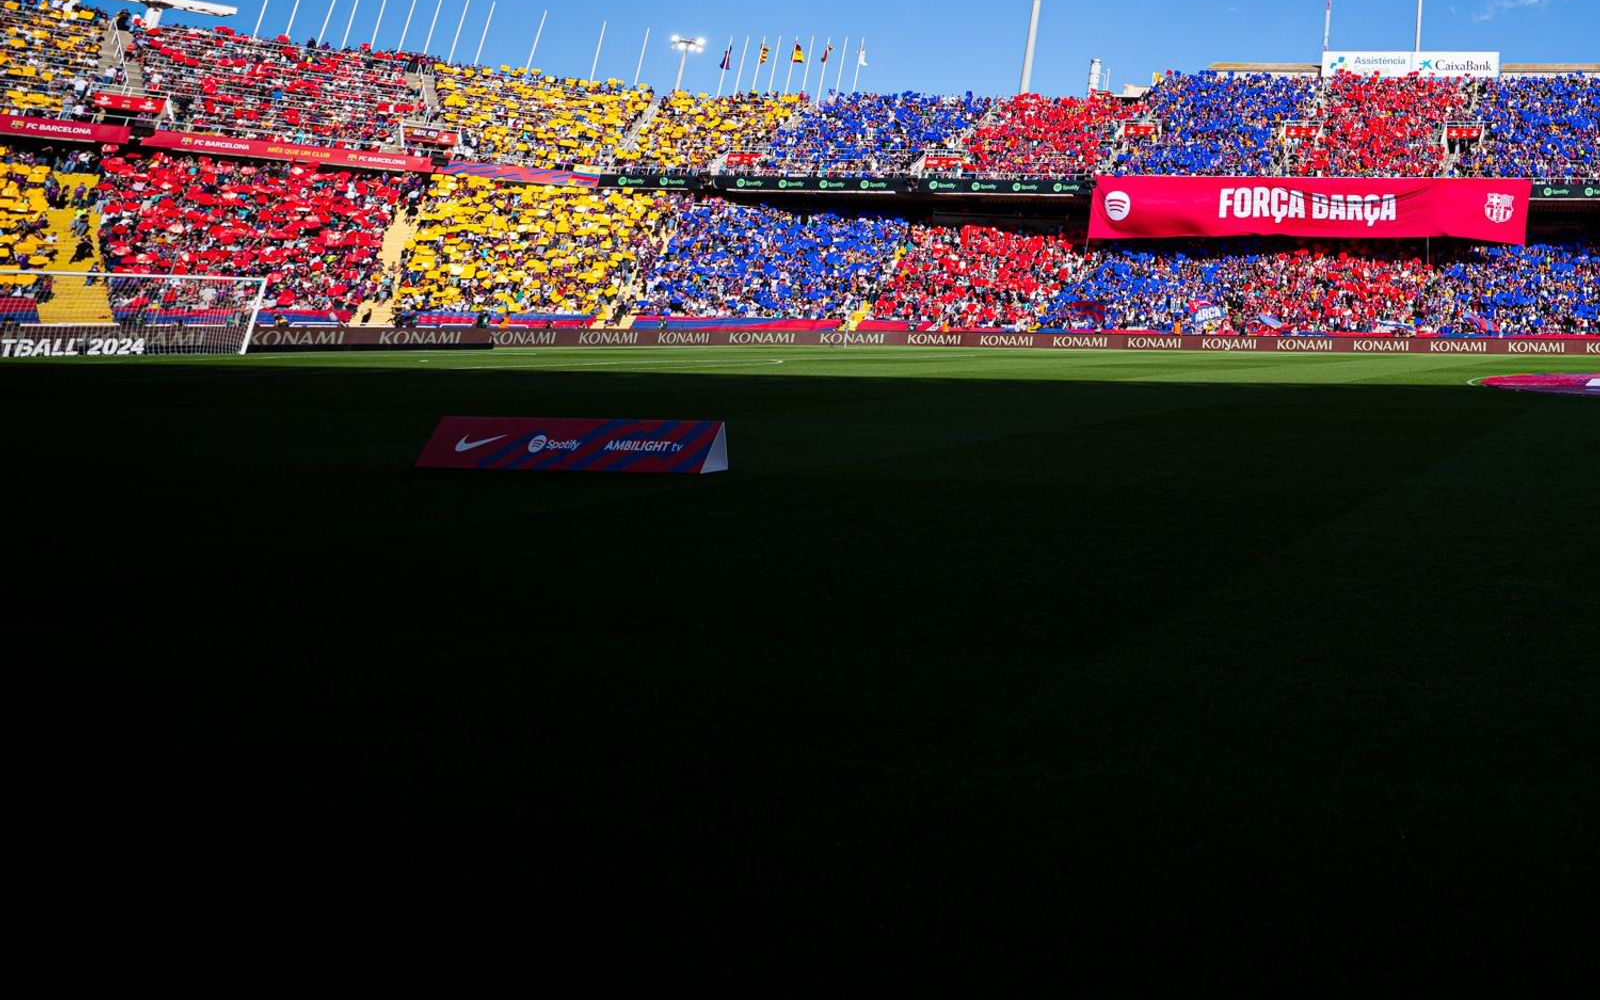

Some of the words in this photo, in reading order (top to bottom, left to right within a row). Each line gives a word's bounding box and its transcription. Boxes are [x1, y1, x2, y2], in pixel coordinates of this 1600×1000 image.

[1354, 56, 1406, 65] Assistència
[1435, 60, 1492, 72] CaixaBank
[26, 122, 38, 130] FC
[39, 124, 91, 135] BARCELONA
[204, 140, 249, 150] BARCELONA
[368, 156, 406, 165] BARCELONA
[1218, 188, 1306, 223] FORÇA
[1312, 193, 1397, 226] BARÇA
[250, 331, 345, 346] KONAMI
[378, 331, 461, 345] KONAMI
[489, 331, 556, 346] KONAMI
[578, 331, 639, 346] KONAMI
[657, 332, 710, 345] KONAMI
[728, 332, 795, 345] KONAMI
[819, 332, 885, 345] KONAMI
[907, 333, 961, 346] KONAMI
[979, 335, 1034, 347] KONAMI
[1052, 335, 1108, 348] KONAMI
[1127, 337, 1182, 349] KONAMI
[1201, 338, 1257, 350] KONAMI
[86, 338, 145, 356] 2024
[1276, 339, 1333, 351] KONAMI
[1353, 339, 1409, 351] KONAMI
[1429, 340, 1487, 352] KONAMI
[1507, 341, 1565, 353] KONAMI
[547, 439, 581, 451] Spotify
[604, 440, 670, 451] AMBILIGHT
[671, 442, 684, 451] tv
